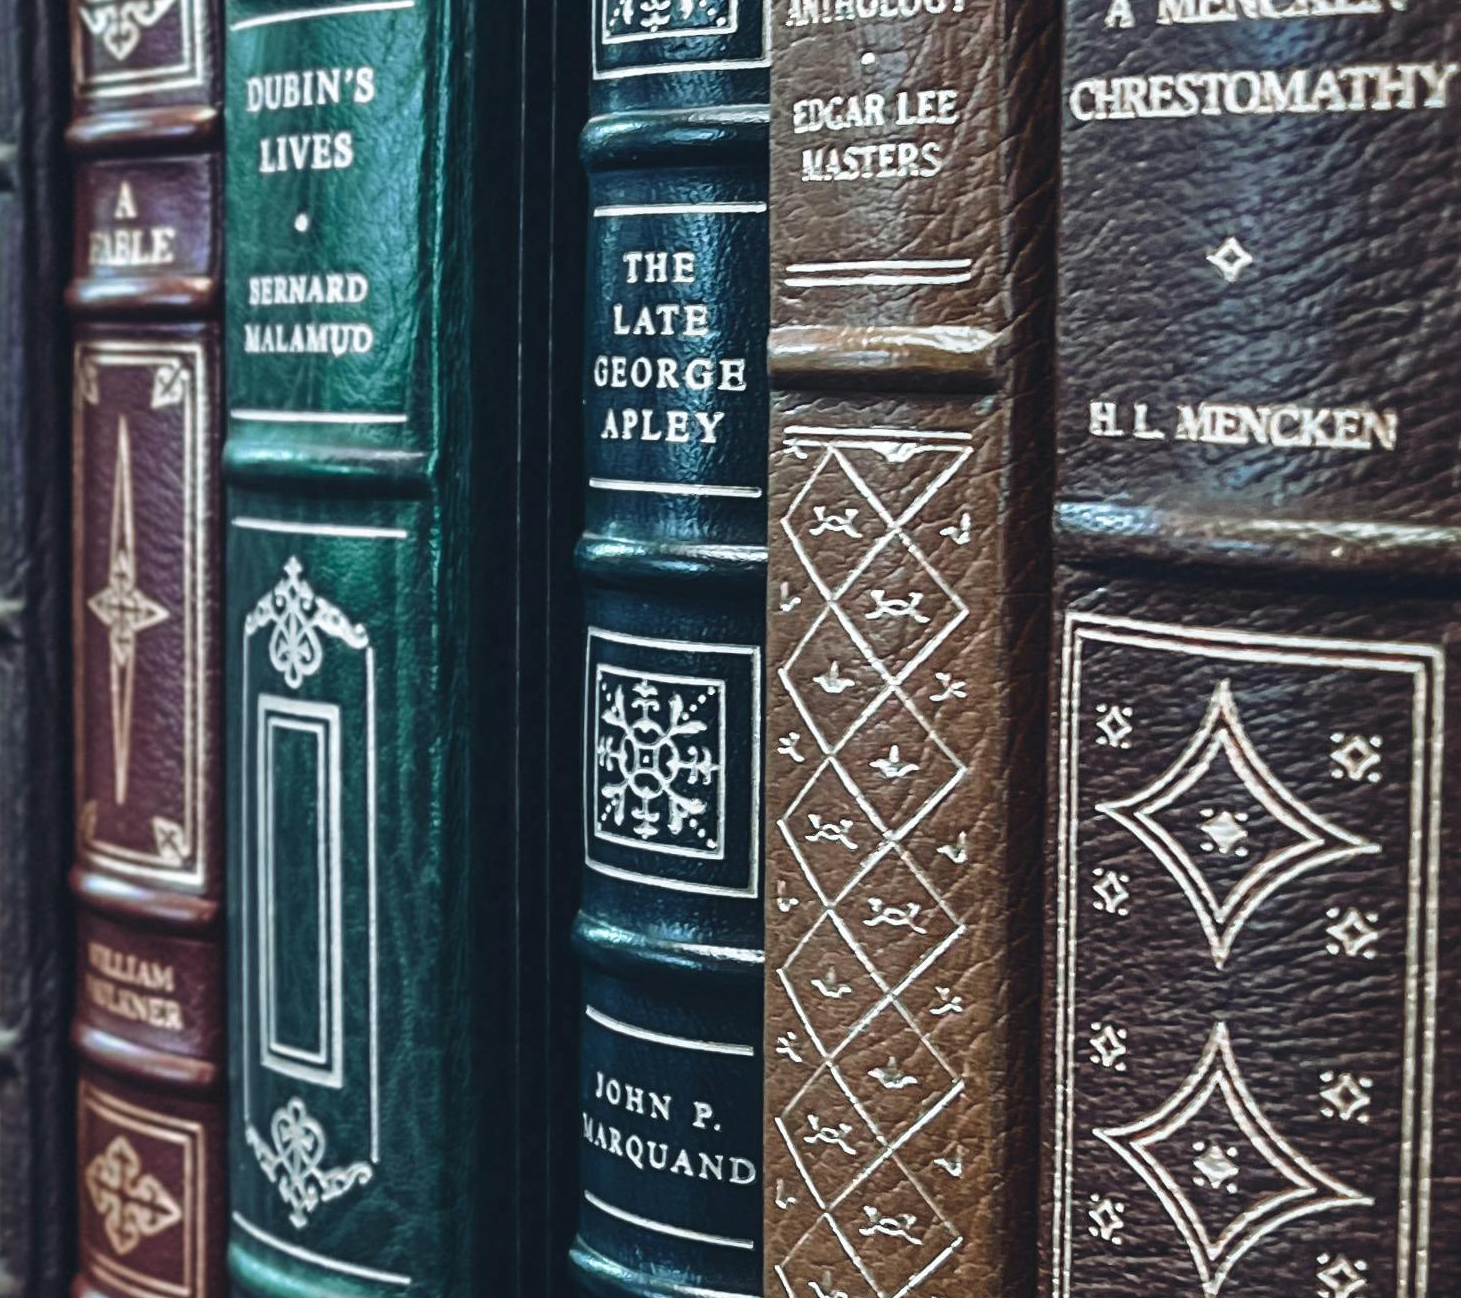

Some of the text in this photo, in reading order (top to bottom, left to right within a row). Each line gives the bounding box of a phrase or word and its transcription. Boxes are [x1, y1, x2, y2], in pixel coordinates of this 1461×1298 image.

[246, 67, 375, 112] DUBIN'S
[1069, 63, 1460, 121] CHRESTOMATHY
[793, 90, 960, 134] EDGAR LEE
[259, 131, 354, 173] LIVES
[801, 142, 943, 182] MASTERS
[114, 181, 137, 219] A
[623, 251, 696, 284] THE
[248, 273, 369, 305] BERNARD
[613, 303, 709, 336] LATE
[244, 323, 374, 357] MALAMUD
[594, 356, 747, 392] GEORGE
[601, 408, 725, 443] APLEY
[1175, 402, 1398, 450] MENCKEN
[595, 1071, 722, 1132] JOHN P.
